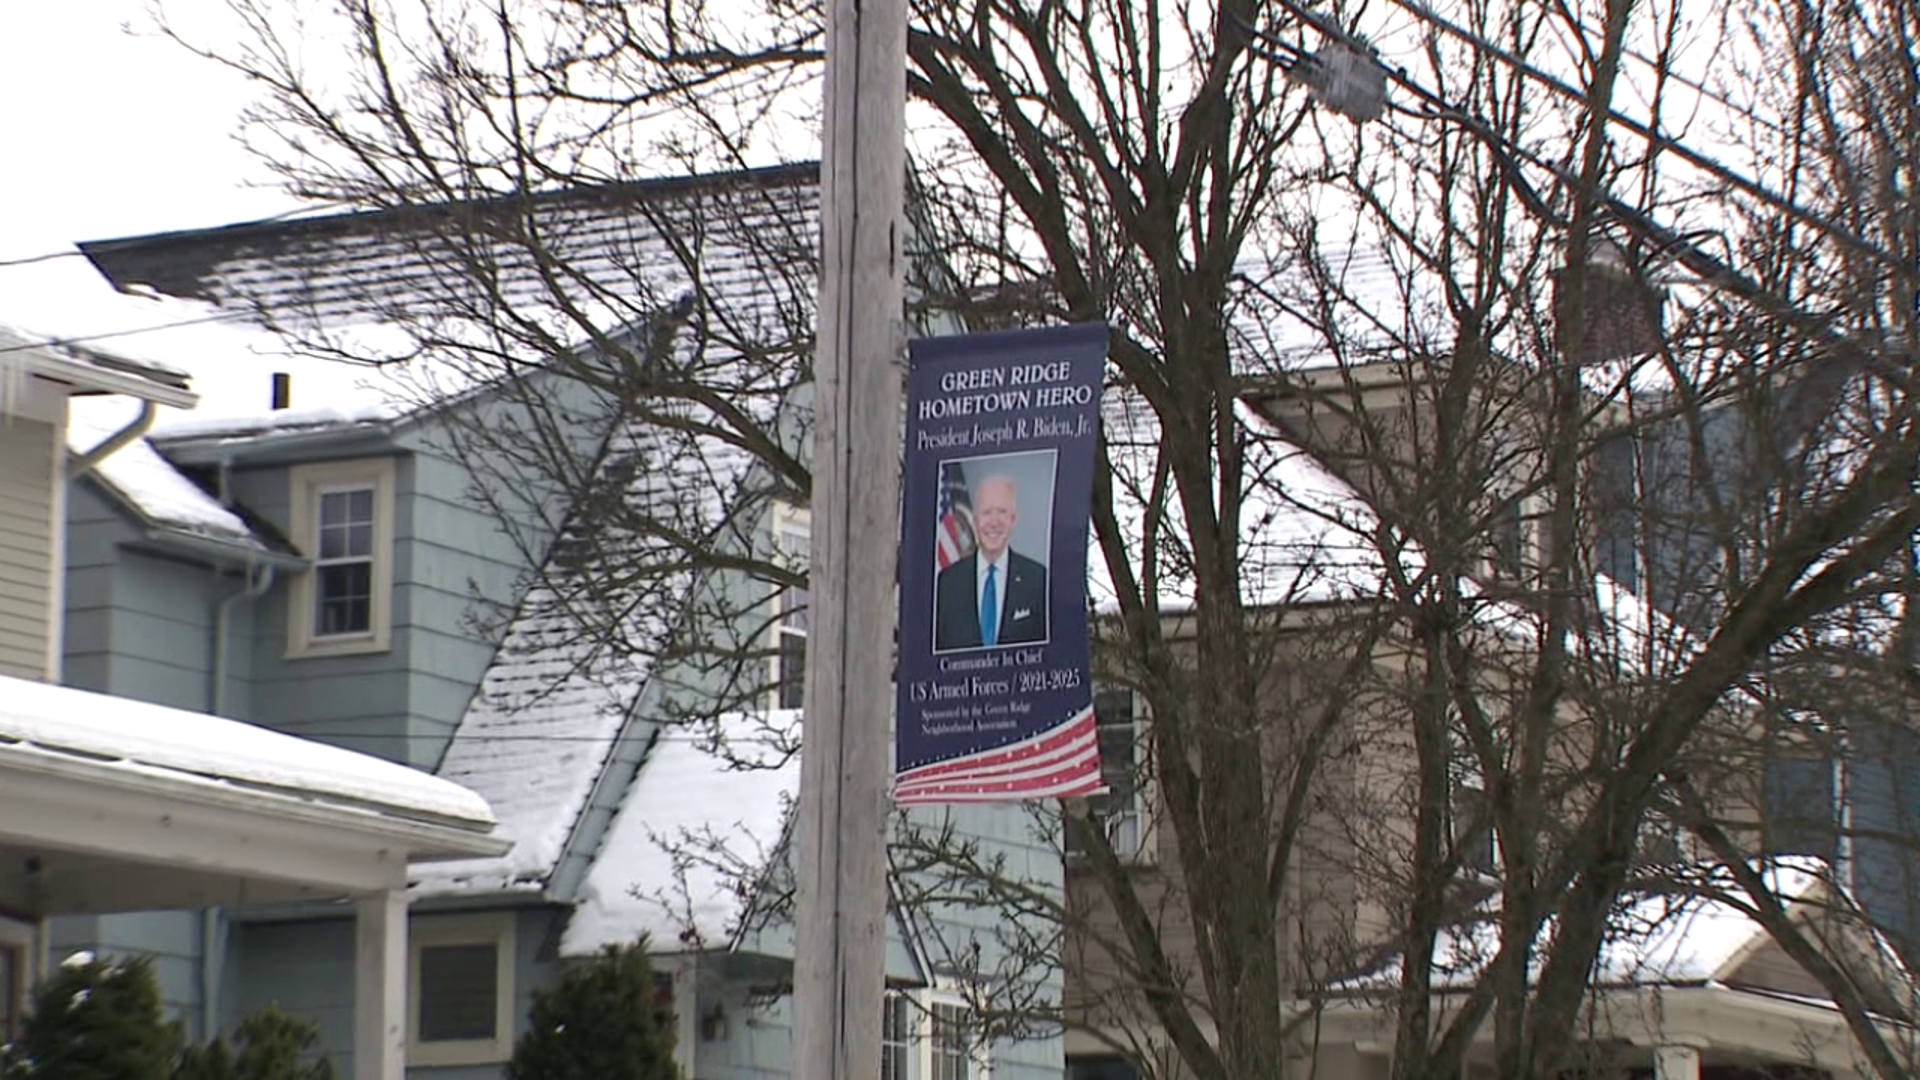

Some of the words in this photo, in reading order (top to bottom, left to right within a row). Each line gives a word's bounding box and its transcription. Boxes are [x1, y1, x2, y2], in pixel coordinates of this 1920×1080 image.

[941, 367, 1005, 392] GREEN
[1011, 361, 1070, 385] RIDGE
[919, 390, 1031, 420] HOMETOWN
[1036, 385, 1092, 408] HERO
[917, 426, 969, 450] President
[971, 421, 1013, 446] Joseph
[1016, 418, 1029, 440] R.
[1033, 415, 1074, 439] Biden,
[1074, 414, 1092, 438] Jr.
[940, 653, 999, 672] Commander
[1002, 653, 1014, 667] In
[1015, 650, 1043, 664] Chief
[910, 682, 927, 702] US
[928, 678, 969, 701] Armed
[971, 676, 1009, 696] Forces
[1020, 668, 1080, 692] 2021-2025
[971, 704, 983, 717] the
[1010, 701, 1031, 714] Ridge
[922, 720, 975, 735] Neighborhood
